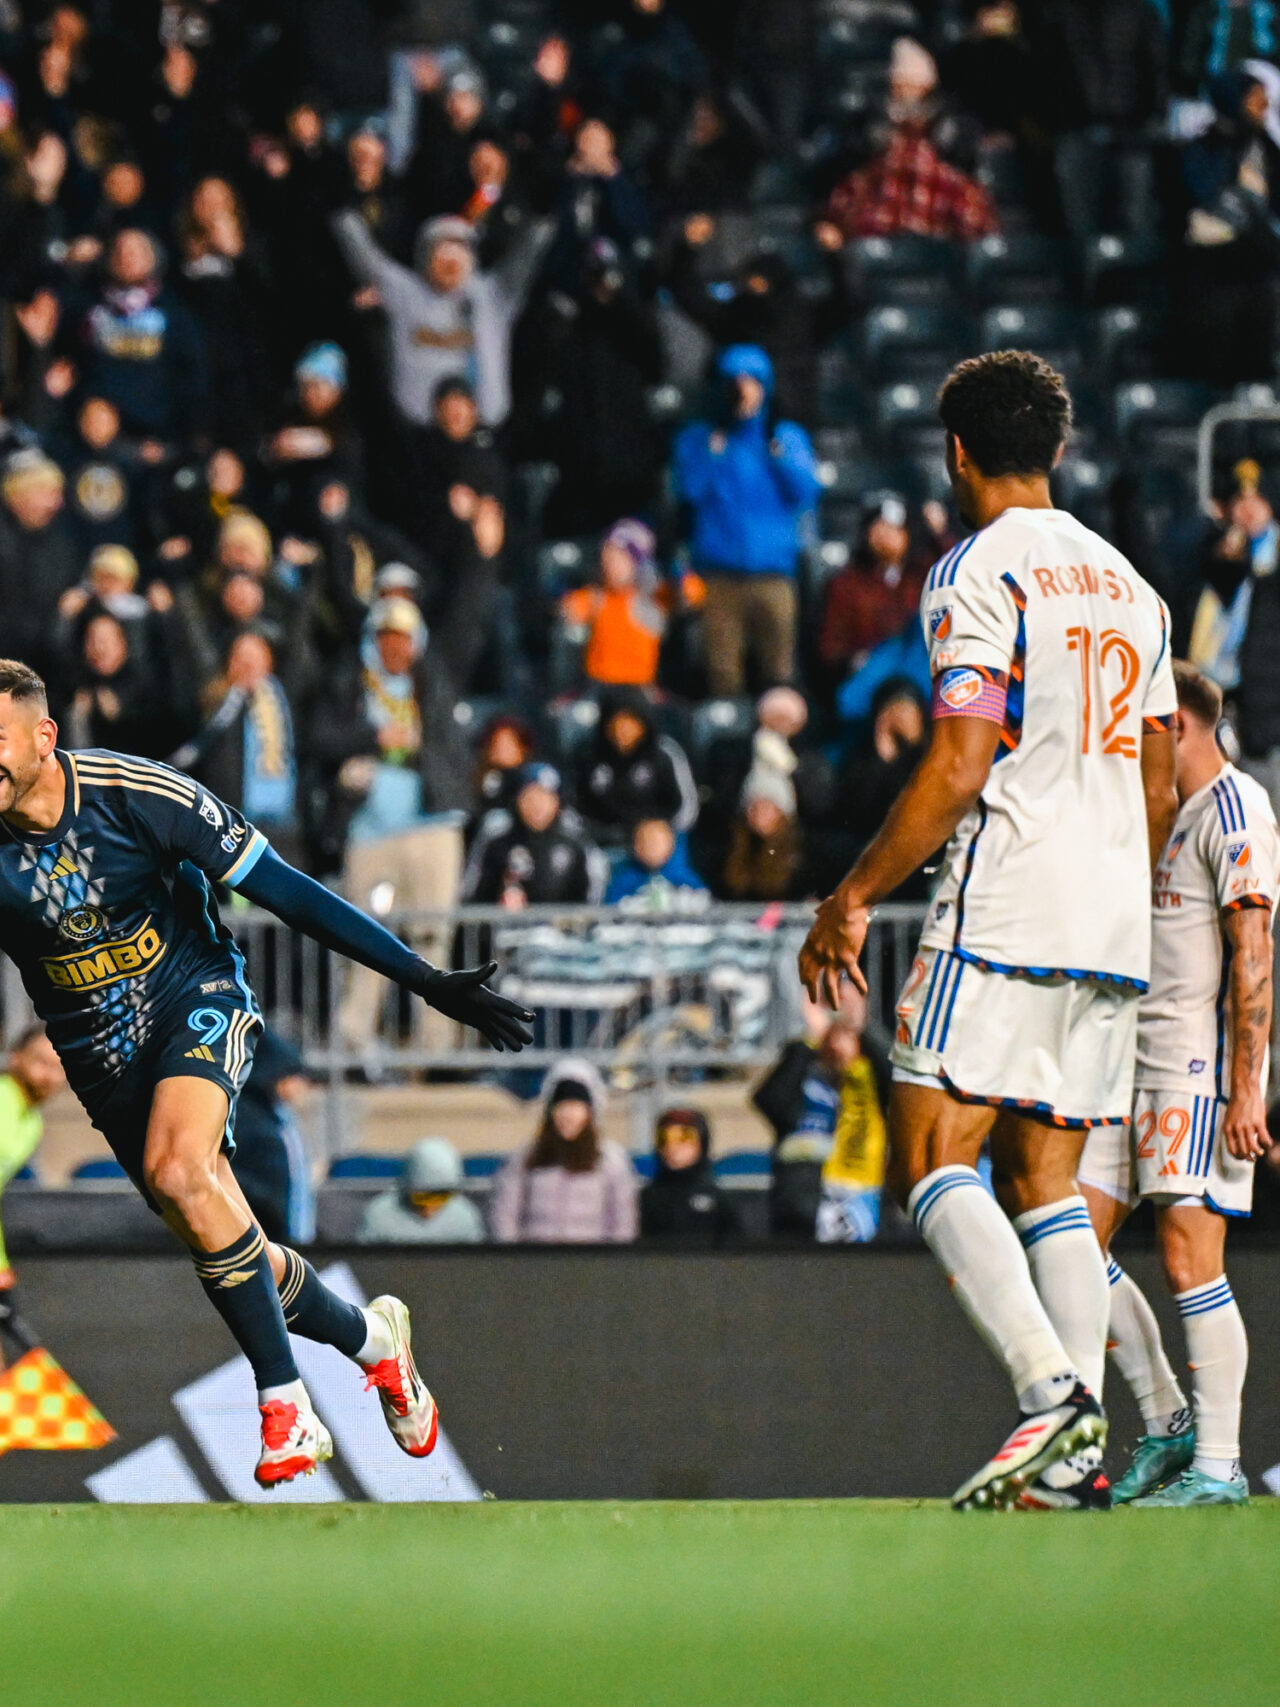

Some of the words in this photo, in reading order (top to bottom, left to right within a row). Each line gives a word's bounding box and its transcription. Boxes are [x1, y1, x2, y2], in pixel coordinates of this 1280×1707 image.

[1065, 626, 1141, 759] 12
[43, 928, 161, 986] BIMBO
[186, 1007, 229, 1046] 9
[1136, 1105, 1191, 1159] 29
